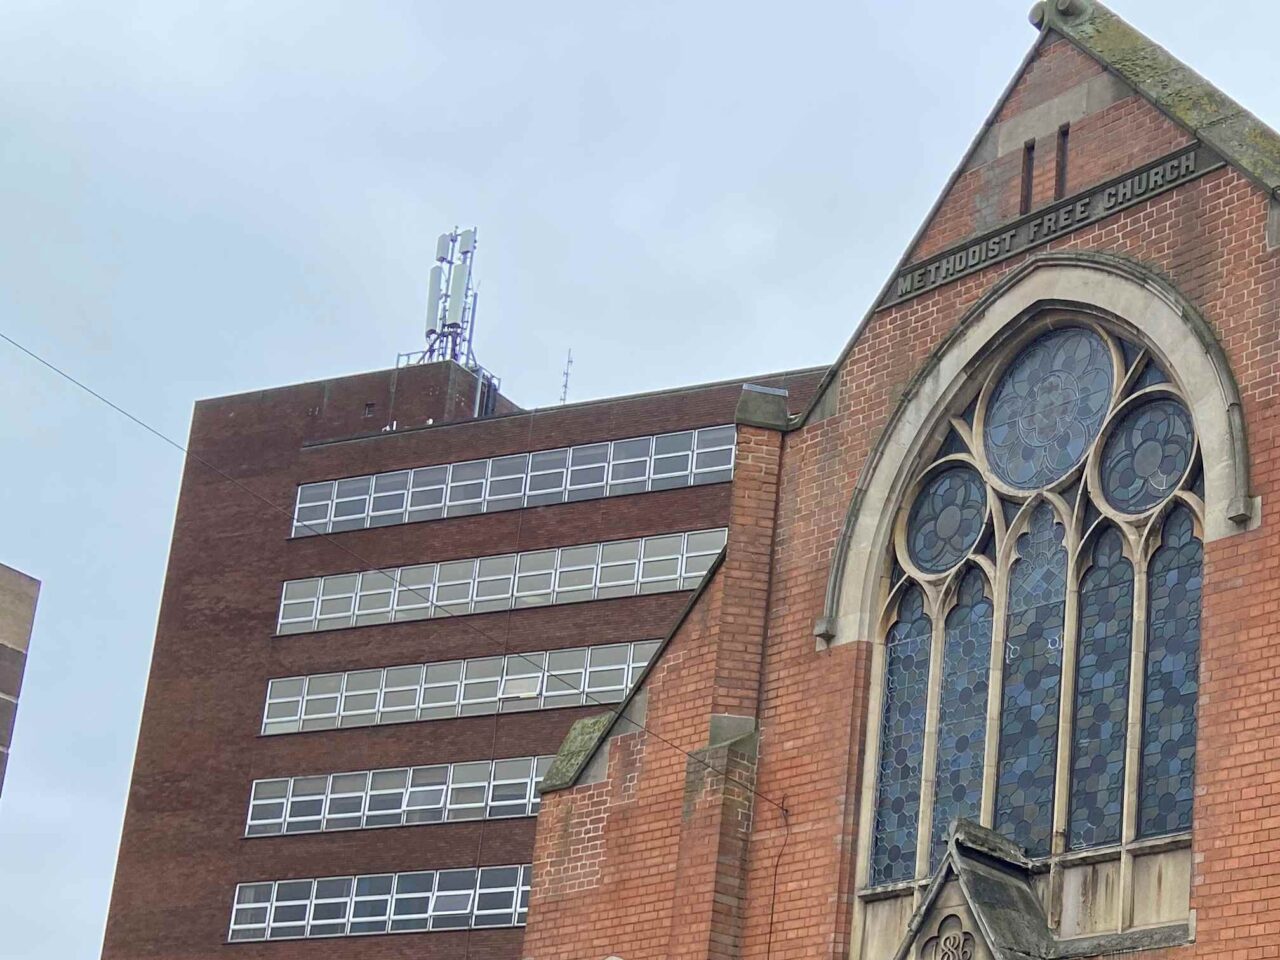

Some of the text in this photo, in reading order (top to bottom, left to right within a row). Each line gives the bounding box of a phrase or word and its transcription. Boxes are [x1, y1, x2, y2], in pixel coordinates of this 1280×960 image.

[897, 151, 1197, 297] METHODIST FREE CHURCH
